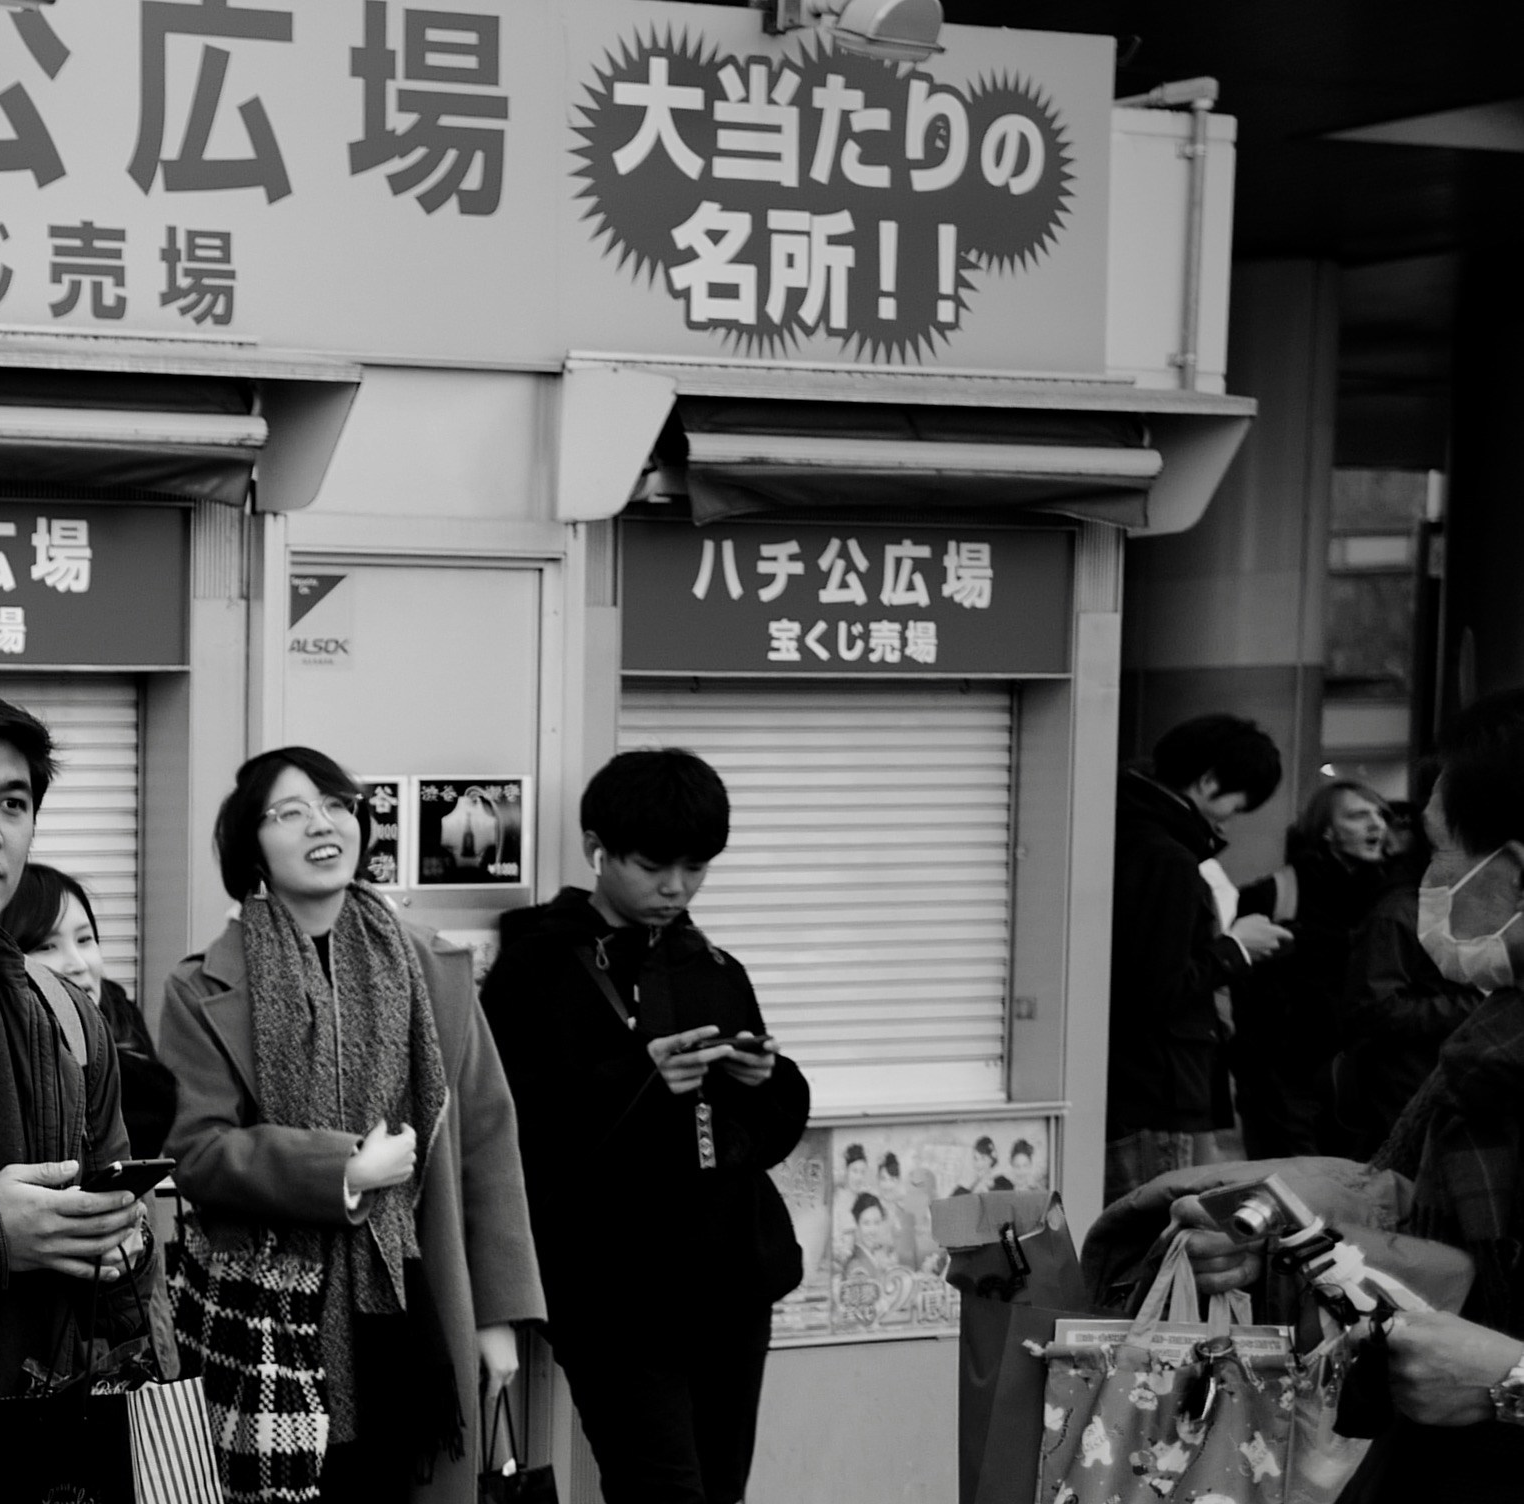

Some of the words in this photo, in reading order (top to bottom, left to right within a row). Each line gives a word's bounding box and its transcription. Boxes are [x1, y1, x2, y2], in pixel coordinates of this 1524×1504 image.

[611, 55, 1047, 196] 大当たりの
[667, 200, 959, 330] 名所!!
[691, 537, 995, 610] ハチ公広場
[288, 638, 351, 656] ALSOK
[765, 617, 940, 665] 宝くじ売場
